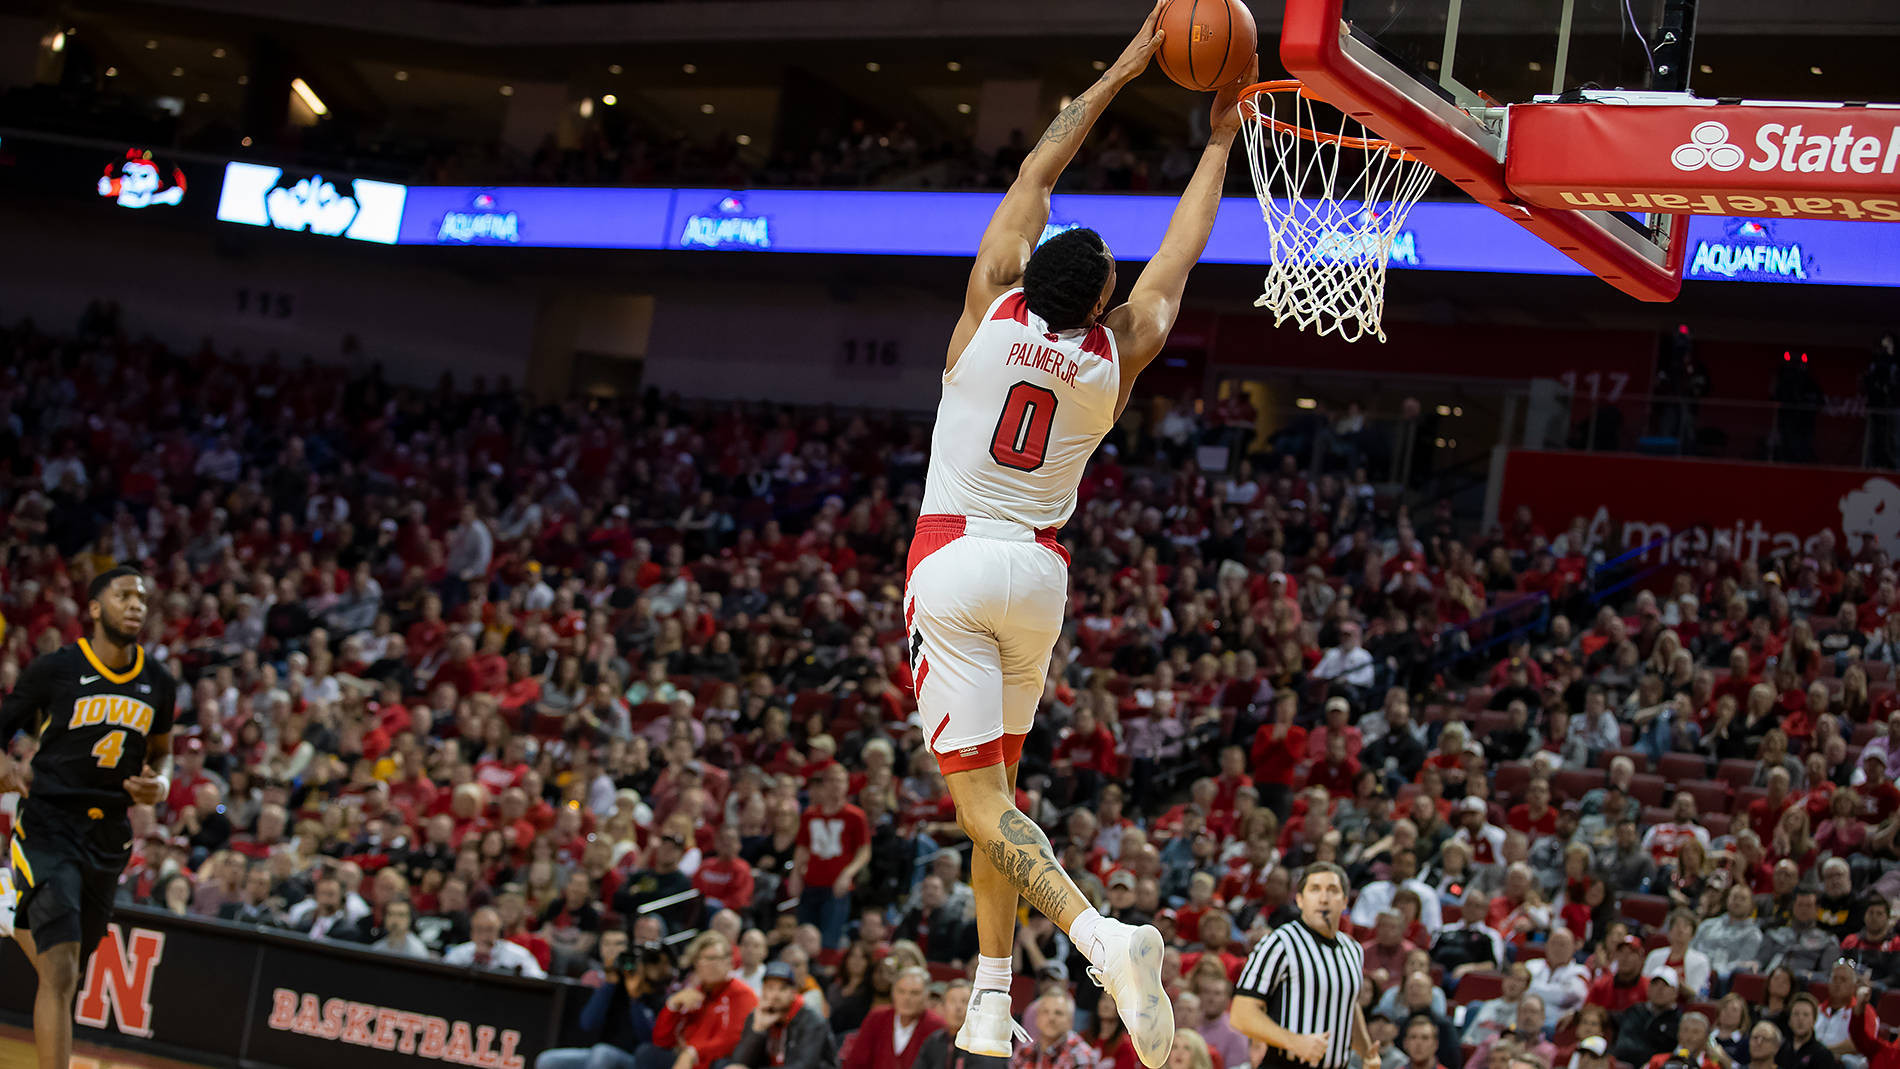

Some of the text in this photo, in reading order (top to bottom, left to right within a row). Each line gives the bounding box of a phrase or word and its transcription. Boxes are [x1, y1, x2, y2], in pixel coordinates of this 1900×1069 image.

[1690, 241, 1808, 280] AQUAFINA
[843, 339, 900, 366] 116
[1005, 343, 1065, 378] PALMER
[1561, 369, 1630, 403] 117
[988, 379, 1059, 474] 0
[68, 693, 155, 736] IOWA
[91, 729, 128, 769] 4
[809, 818, 845, 860] N
[75, 922, 166, 1038] N
[268, 987, 525, 1069] BASKETBALL
